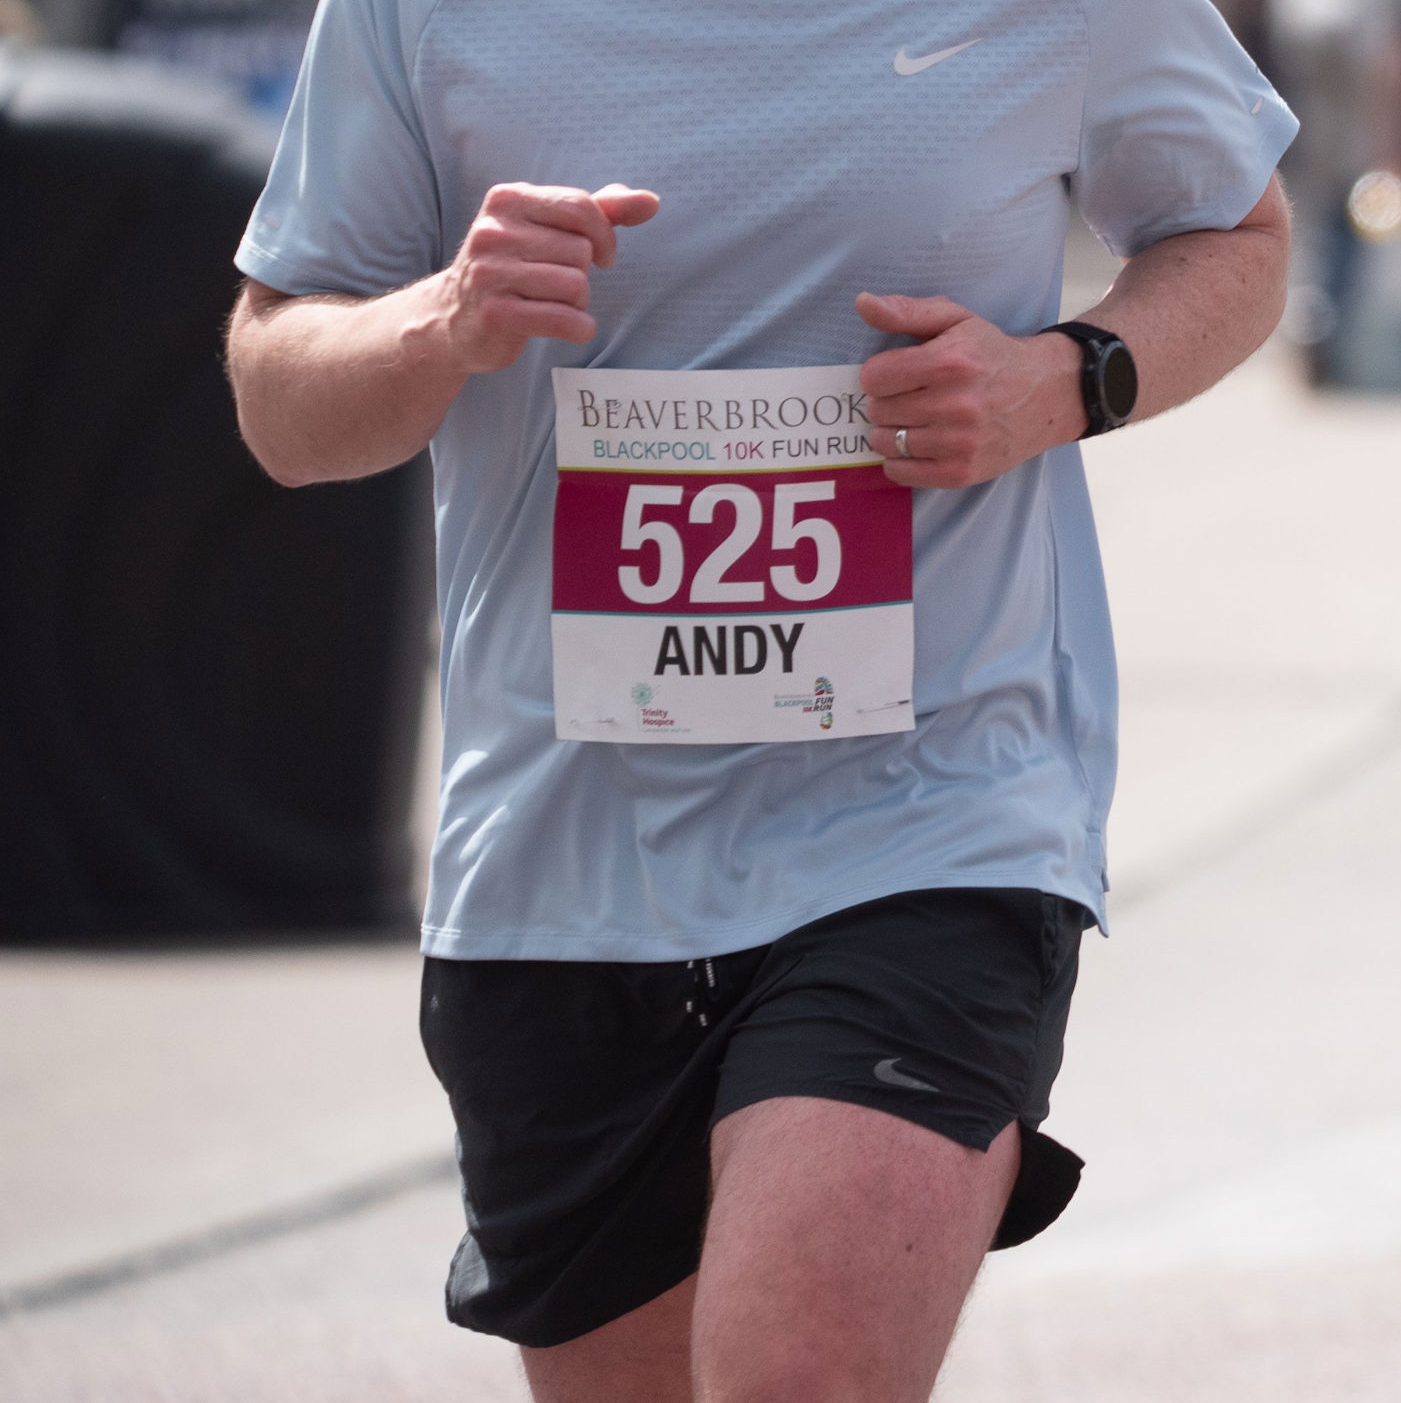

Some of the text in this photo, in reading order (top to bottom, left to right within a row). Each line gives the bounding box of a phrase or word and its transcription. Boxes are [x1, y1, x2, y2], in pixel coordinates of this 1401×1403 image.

[578, 389, 872, 432] BEAVERBROOK
[593, 435, 873, 461] BLACKPOOL 10K FUN RUN
[618, 480, 842, 604] 525
[654, 622, 805, 676] ANDY
[641, 708, 668, 719] Trinity
[642, 718, 675, 727] Hospice
